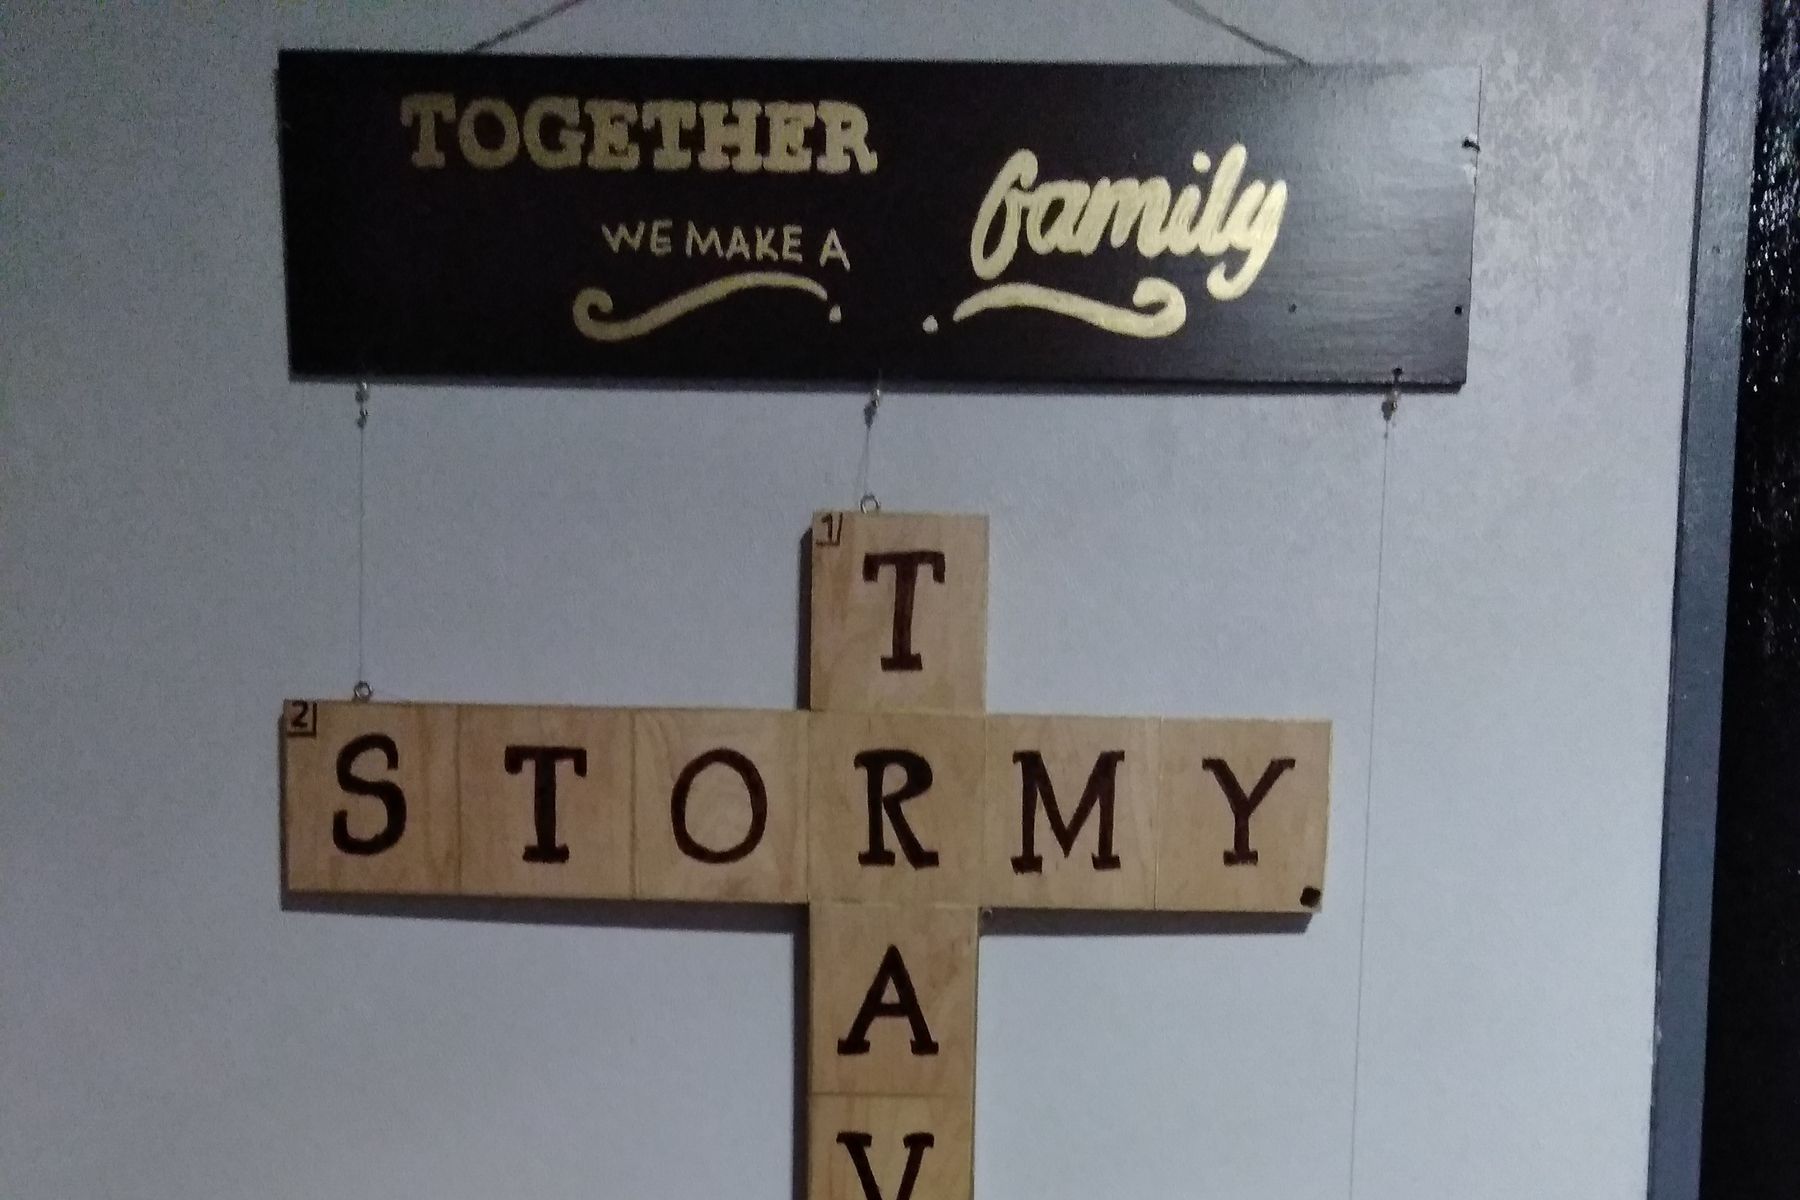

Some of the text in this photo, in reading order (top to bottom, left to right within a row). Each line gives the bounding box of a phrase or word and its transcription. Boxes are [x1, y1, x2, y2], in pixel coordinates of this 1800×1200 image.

[400, 92, 878, 175] TOGETHER
[601, 219, 851, 272] WE MAKE A
[968, 141, 1288, 301] family
[290, 700, 308, 728] 2
[331, 732, 1297, 875] STORMY
